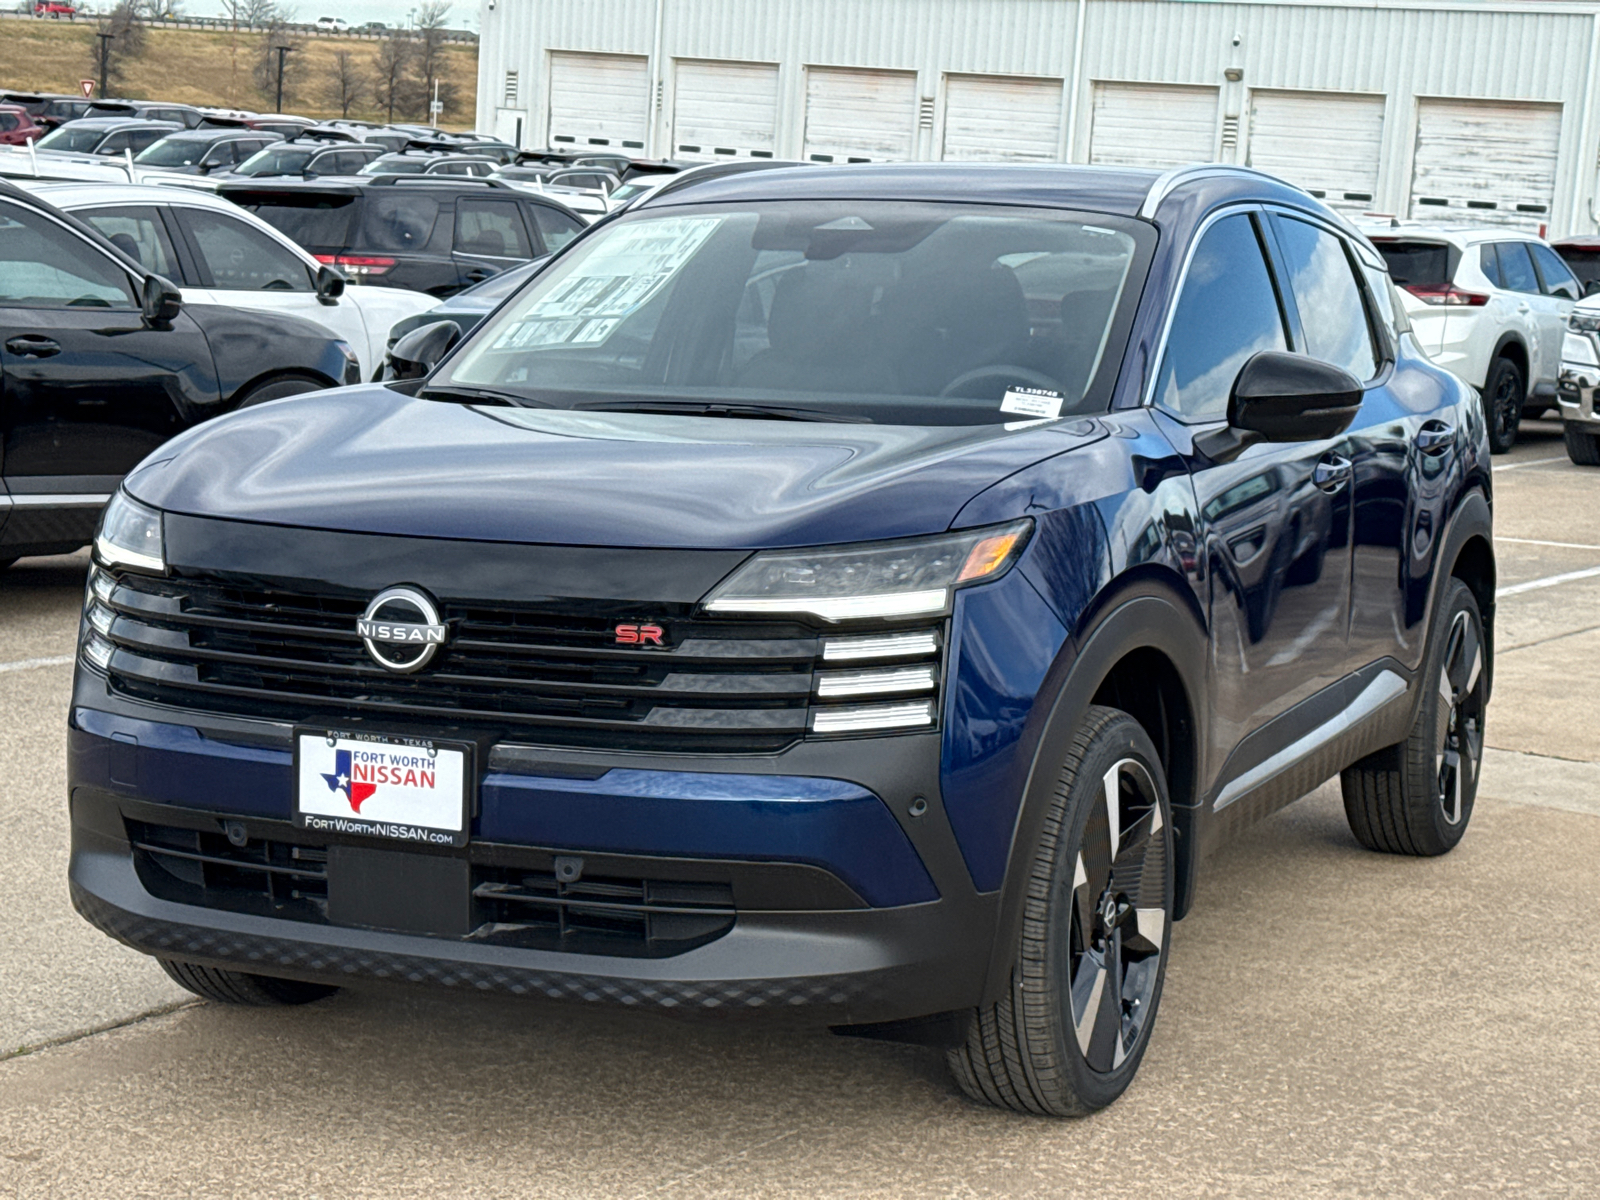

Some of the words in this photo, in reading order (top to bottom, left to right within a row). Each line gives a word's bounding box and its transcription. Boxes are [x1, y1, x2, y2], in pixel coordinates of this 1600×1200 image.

[357, 622, 443, 641] NISSAN
[615, 624, 663, 645] SR
[327, 730, 351, 741] FORT
[355, 733, 389, 743] WORTH
[402, 738, 433, 748] TEXAS
[353, 750, 386, 764] FORT
[389, 754, 435, 769] WORTH
[353, 763, 435, 789] NISSAN
